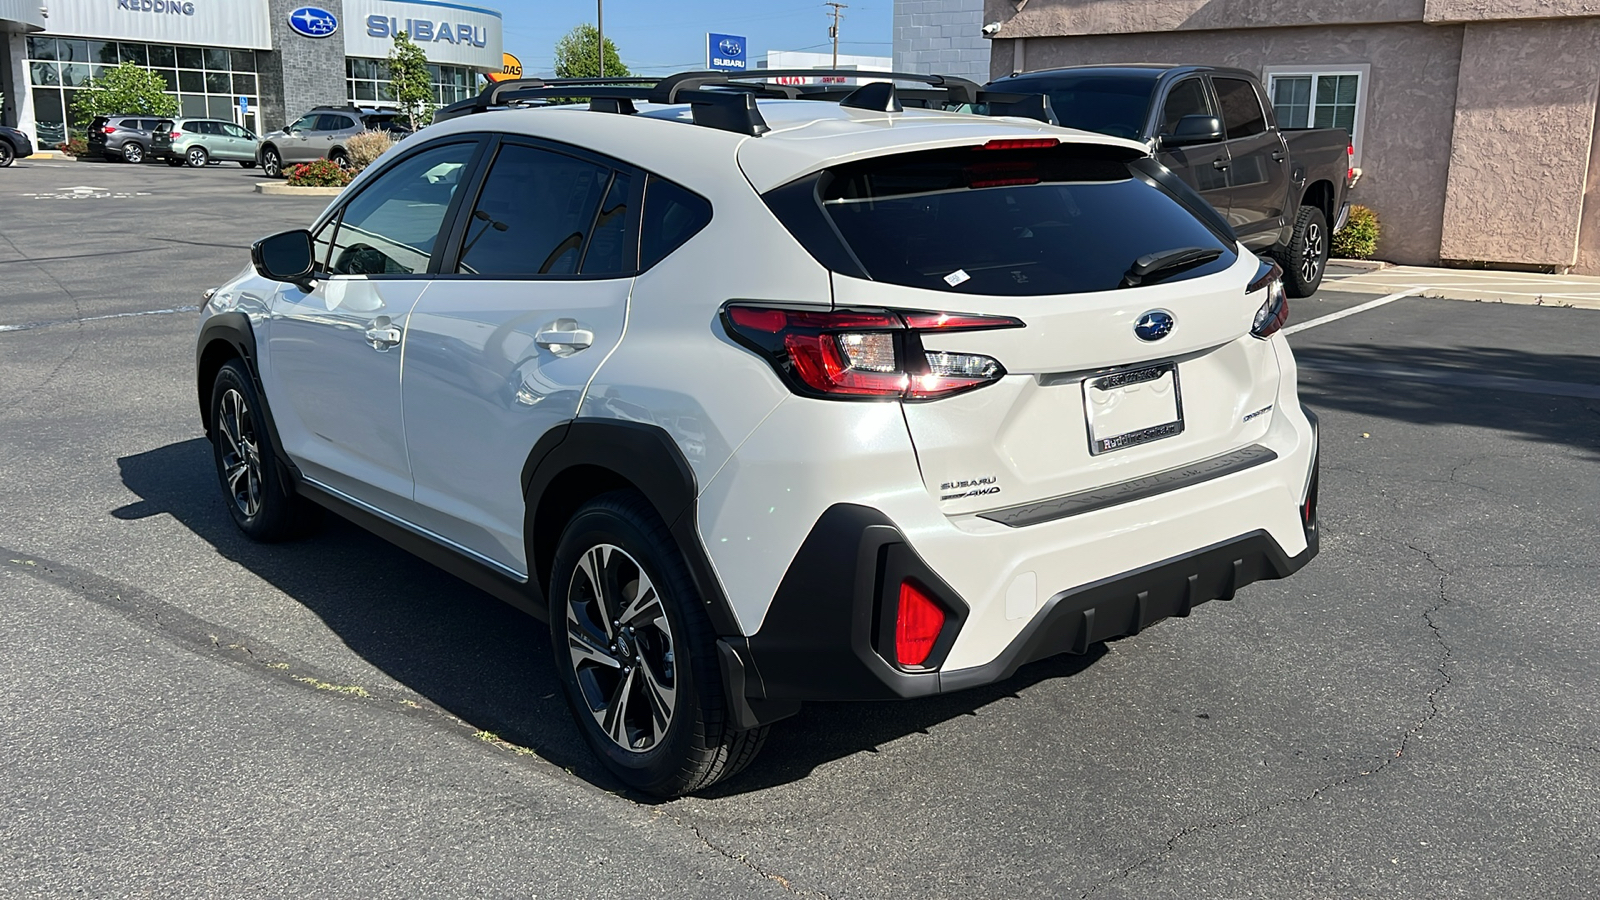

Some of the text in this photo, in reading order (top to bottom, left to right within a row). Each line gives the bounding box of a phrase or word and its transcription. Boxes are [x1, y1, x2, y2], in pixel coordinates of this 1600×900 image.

[117, 0, 195, 16] REDDING
[366, 14, 487, 48] SUBARU
[713, 58, 745, 68] SUBARU
[502, 65, 521, 75] DAS
[940, 476, 997, 490] SUBARU
[964, 486, 1001, 498] AWD
